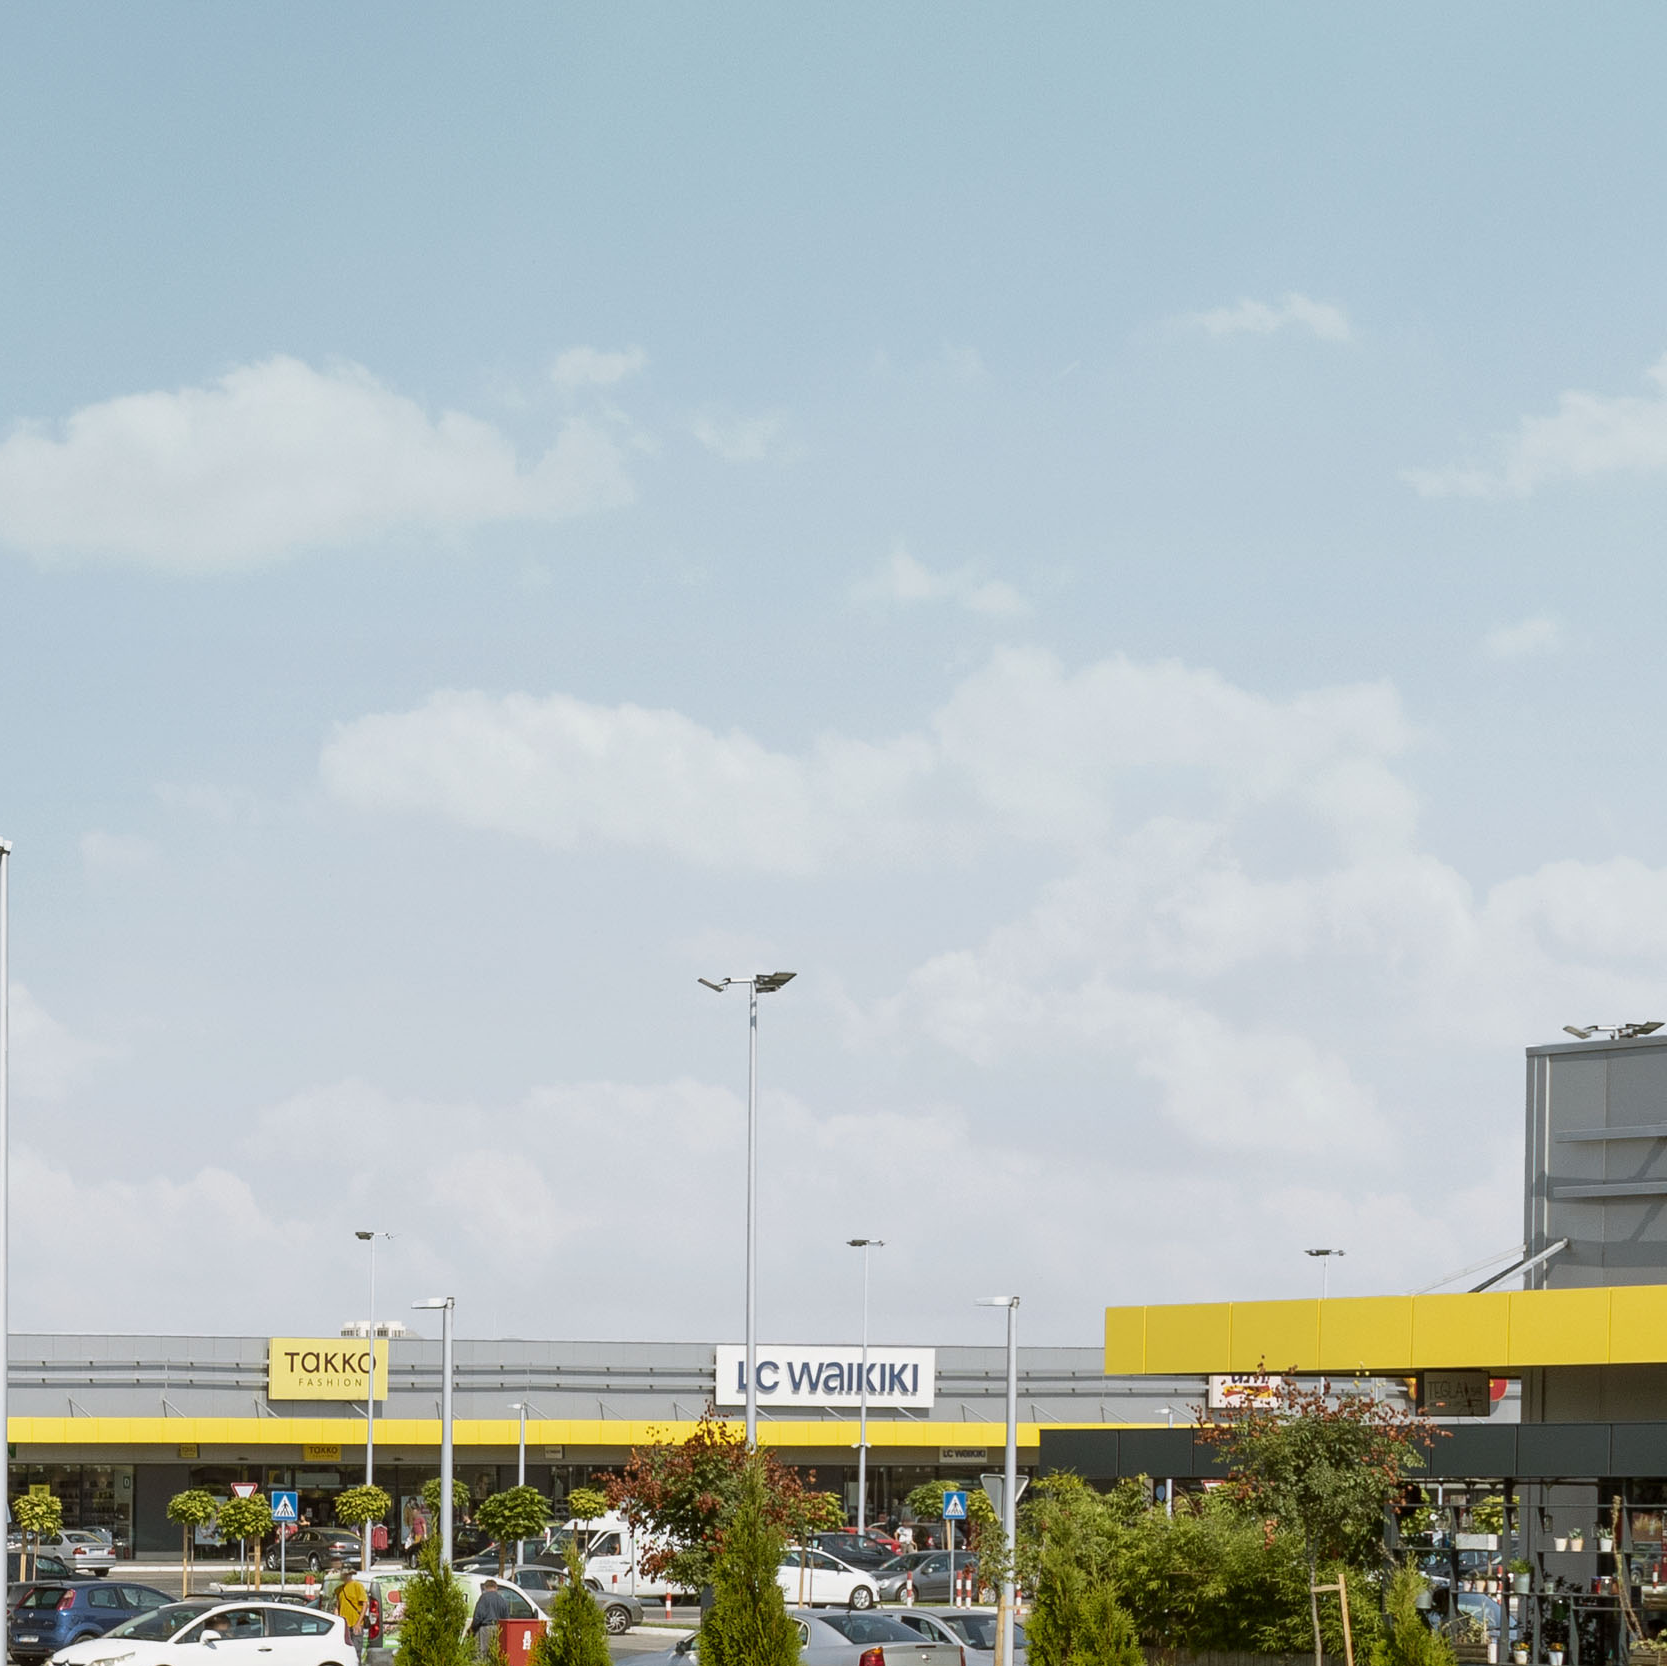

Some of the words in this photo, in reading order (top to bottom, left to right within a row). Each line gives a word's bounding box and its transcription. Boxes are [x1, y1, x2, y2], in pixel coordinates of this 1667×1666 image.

[737, 1360, 780, 1391] LC
[299, 1378, 362, 1387] FASHION
[942, 1449, 954, 1458] LC
